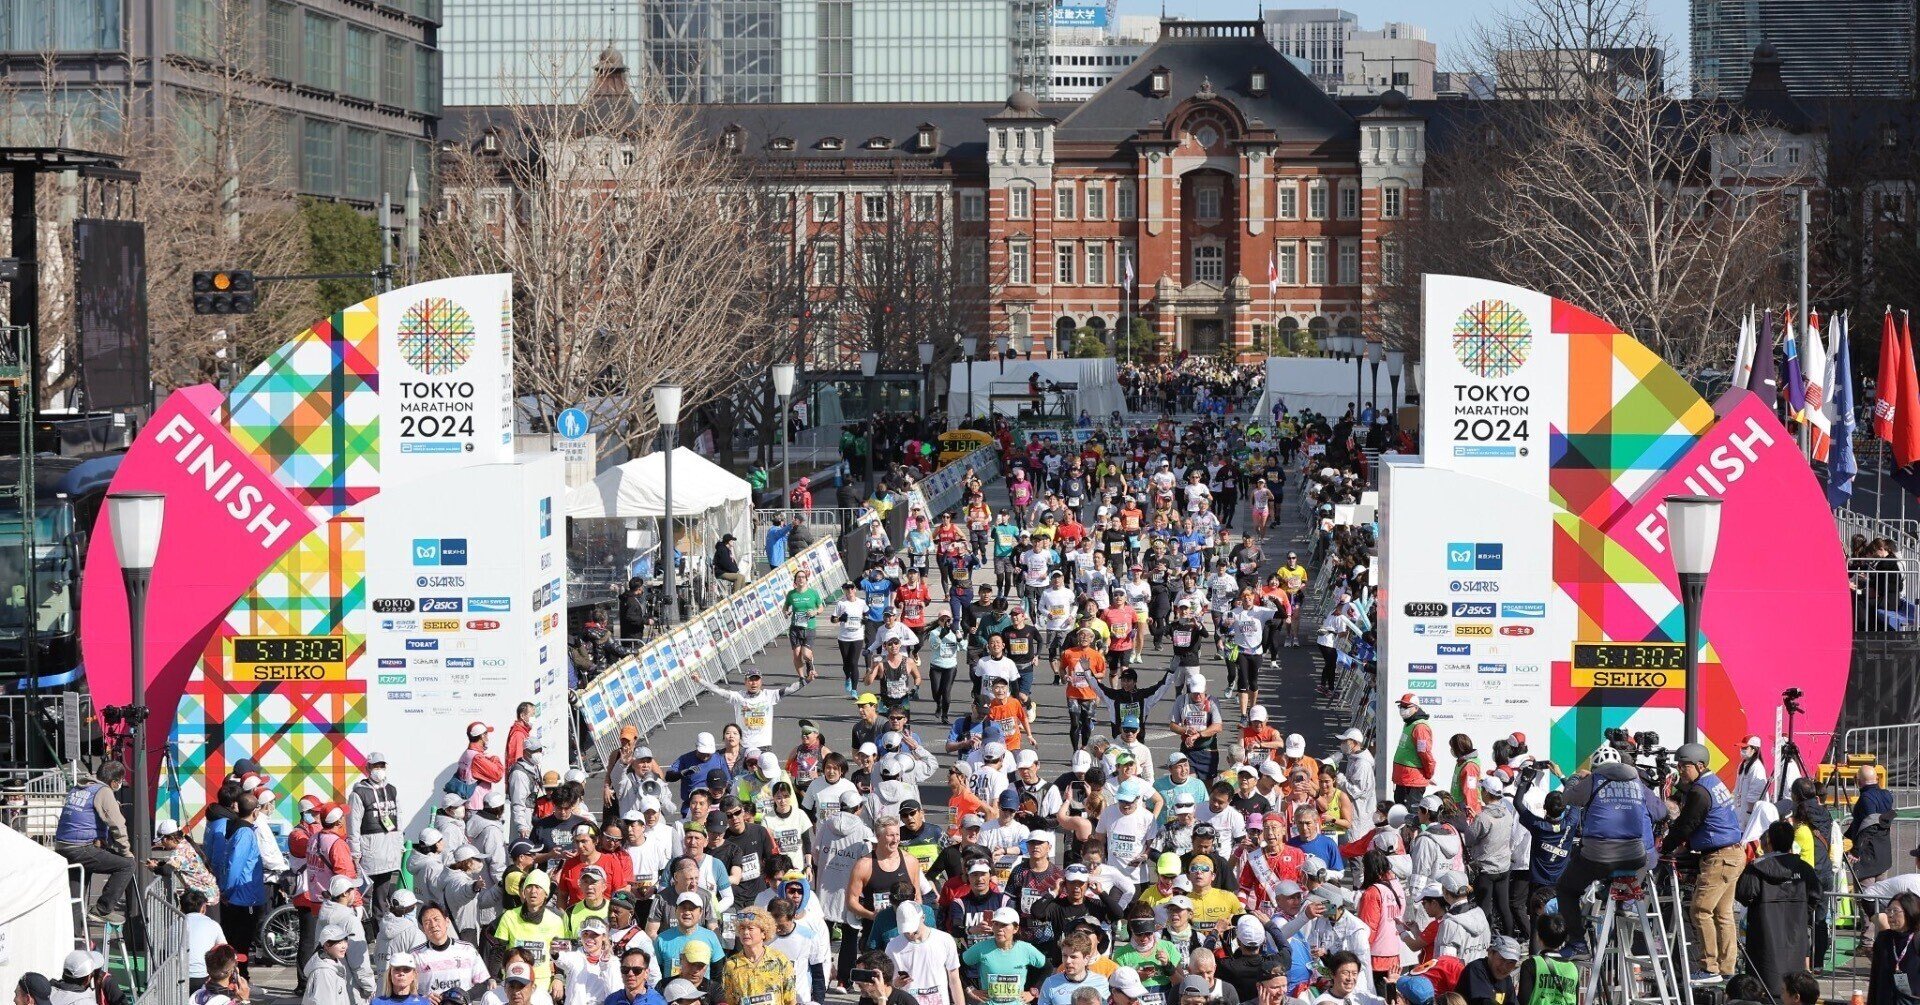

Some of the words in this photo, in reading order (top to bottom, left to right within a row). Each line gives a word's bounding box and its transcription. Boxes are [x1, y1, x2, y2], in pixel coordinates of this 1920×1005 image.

[1055, 9, 1095, 19] 近畿大学
[400, 382, 474, 398] TOKYO
[1454, 385, 1530, 402] TOKYO
[401, 402, 473, 412] MARATHON
[1455, 406, 1528, 415] MARATHON
[400, 416, 474, 437] 2024
[1454, 419, 1529, 441] 2024
[155, 414, 291, 548] FINISH
[1635, 416, 1774, 554] FISH
[434, 600, 458, 610] asics
[1467, 606, 1492, 615] asics
[424, 621, 459, 629] SEIKO
[1457, 626, 1492, 635] SEIKO
[256, 640, 340, 660] 5:13:02
[1597, 647, 1682, 668] 5:13:02
[254, 665, 325, 680] SEIKO
[1594, 672, 1667, 687] SEIKO
[823, 846, 856, 859] OFICIAL
[1207, 906, 1226, 914] BCU
